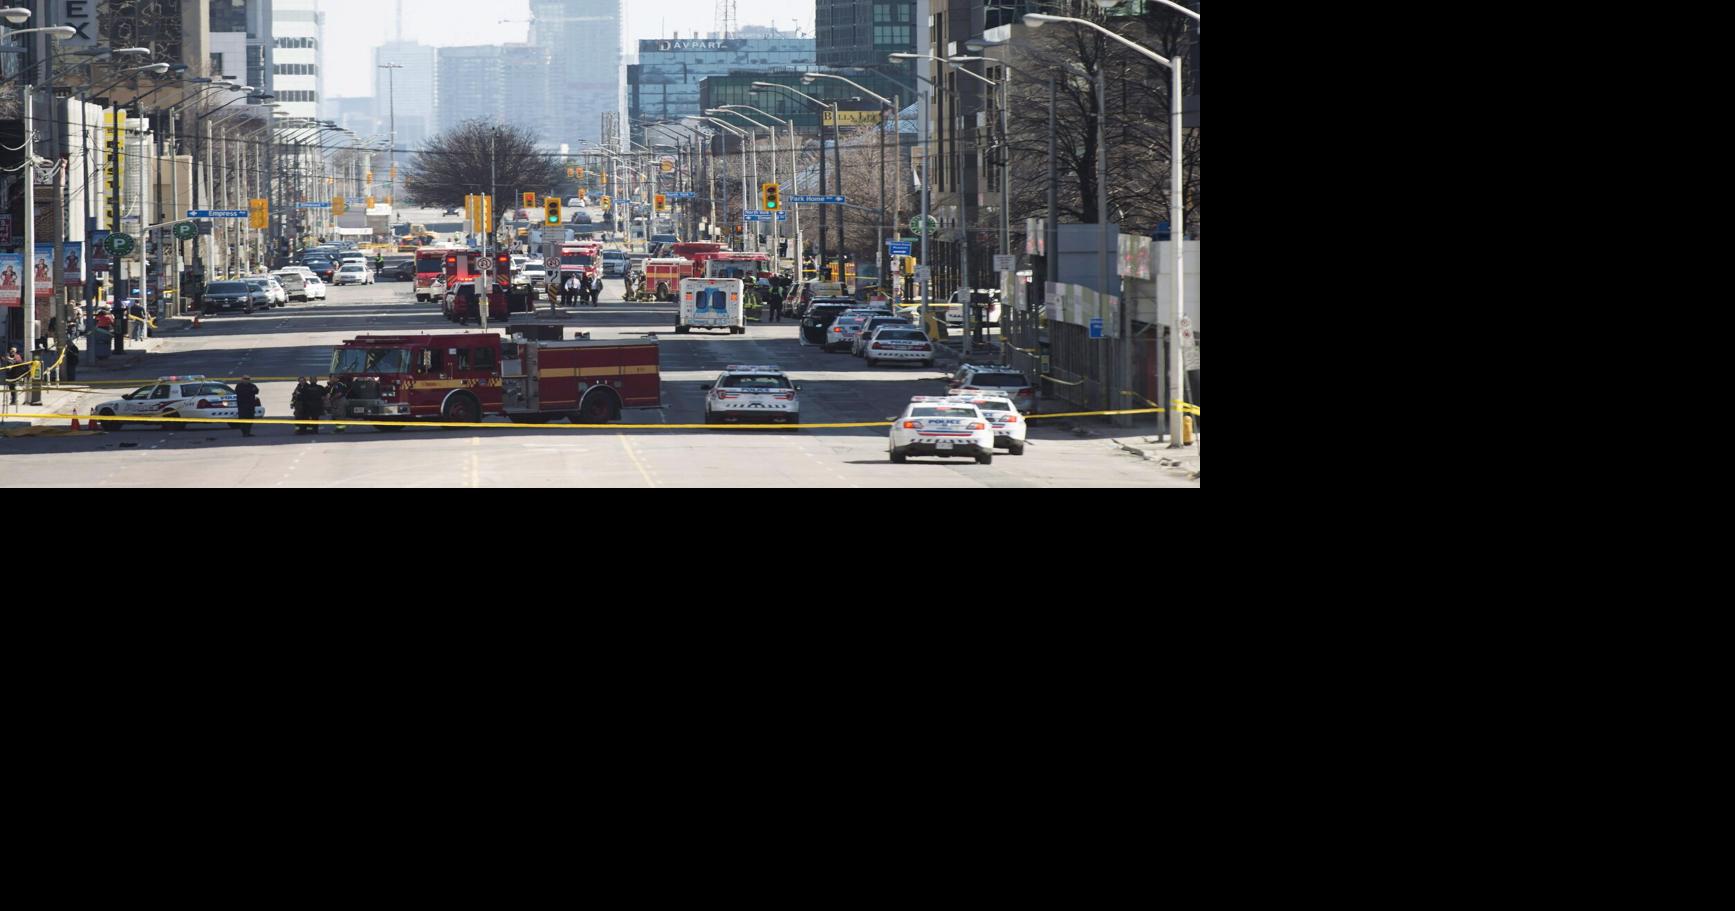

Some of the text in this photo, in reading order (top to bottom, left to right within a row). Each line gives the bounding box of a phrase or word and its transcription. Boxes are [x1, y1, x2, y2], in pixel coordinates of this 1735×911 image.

[660, 41, 721, 50] DAVPART
[208, 210, 238, 218] Empress
[180, 225, 190, 234] P
[113, 238, 126, 249] P
